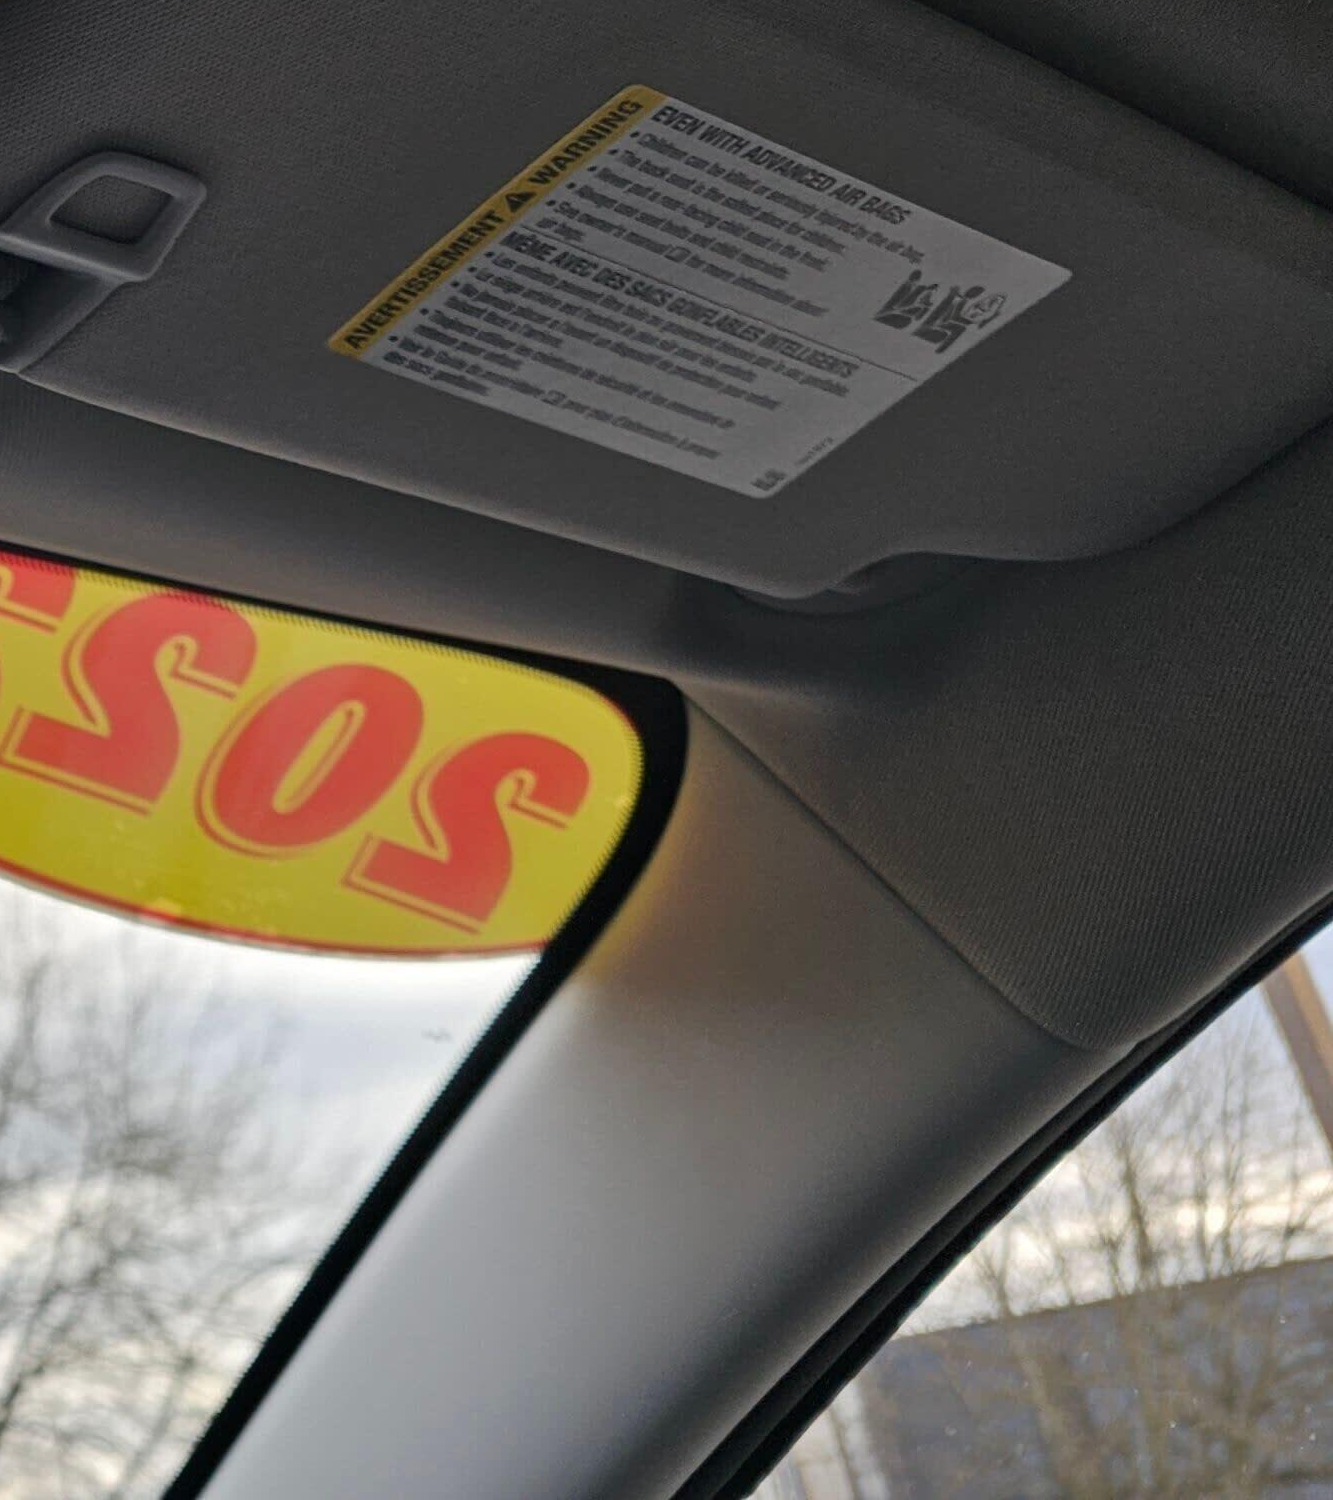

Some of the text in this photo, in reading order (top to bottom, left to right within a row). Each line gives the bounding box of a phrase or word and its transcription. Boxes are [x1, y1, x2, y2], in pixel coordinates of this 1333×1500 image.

[528, 100, 643, 186] WARNING
[648, 103, 912, 225] EVEN WITH ADVANCED AIR BAGS
[343, 210, 505, 350] AVERTISSEMENT
[546, 248, 602, 278] AVEC
[588, 265, 636, 292] DES
